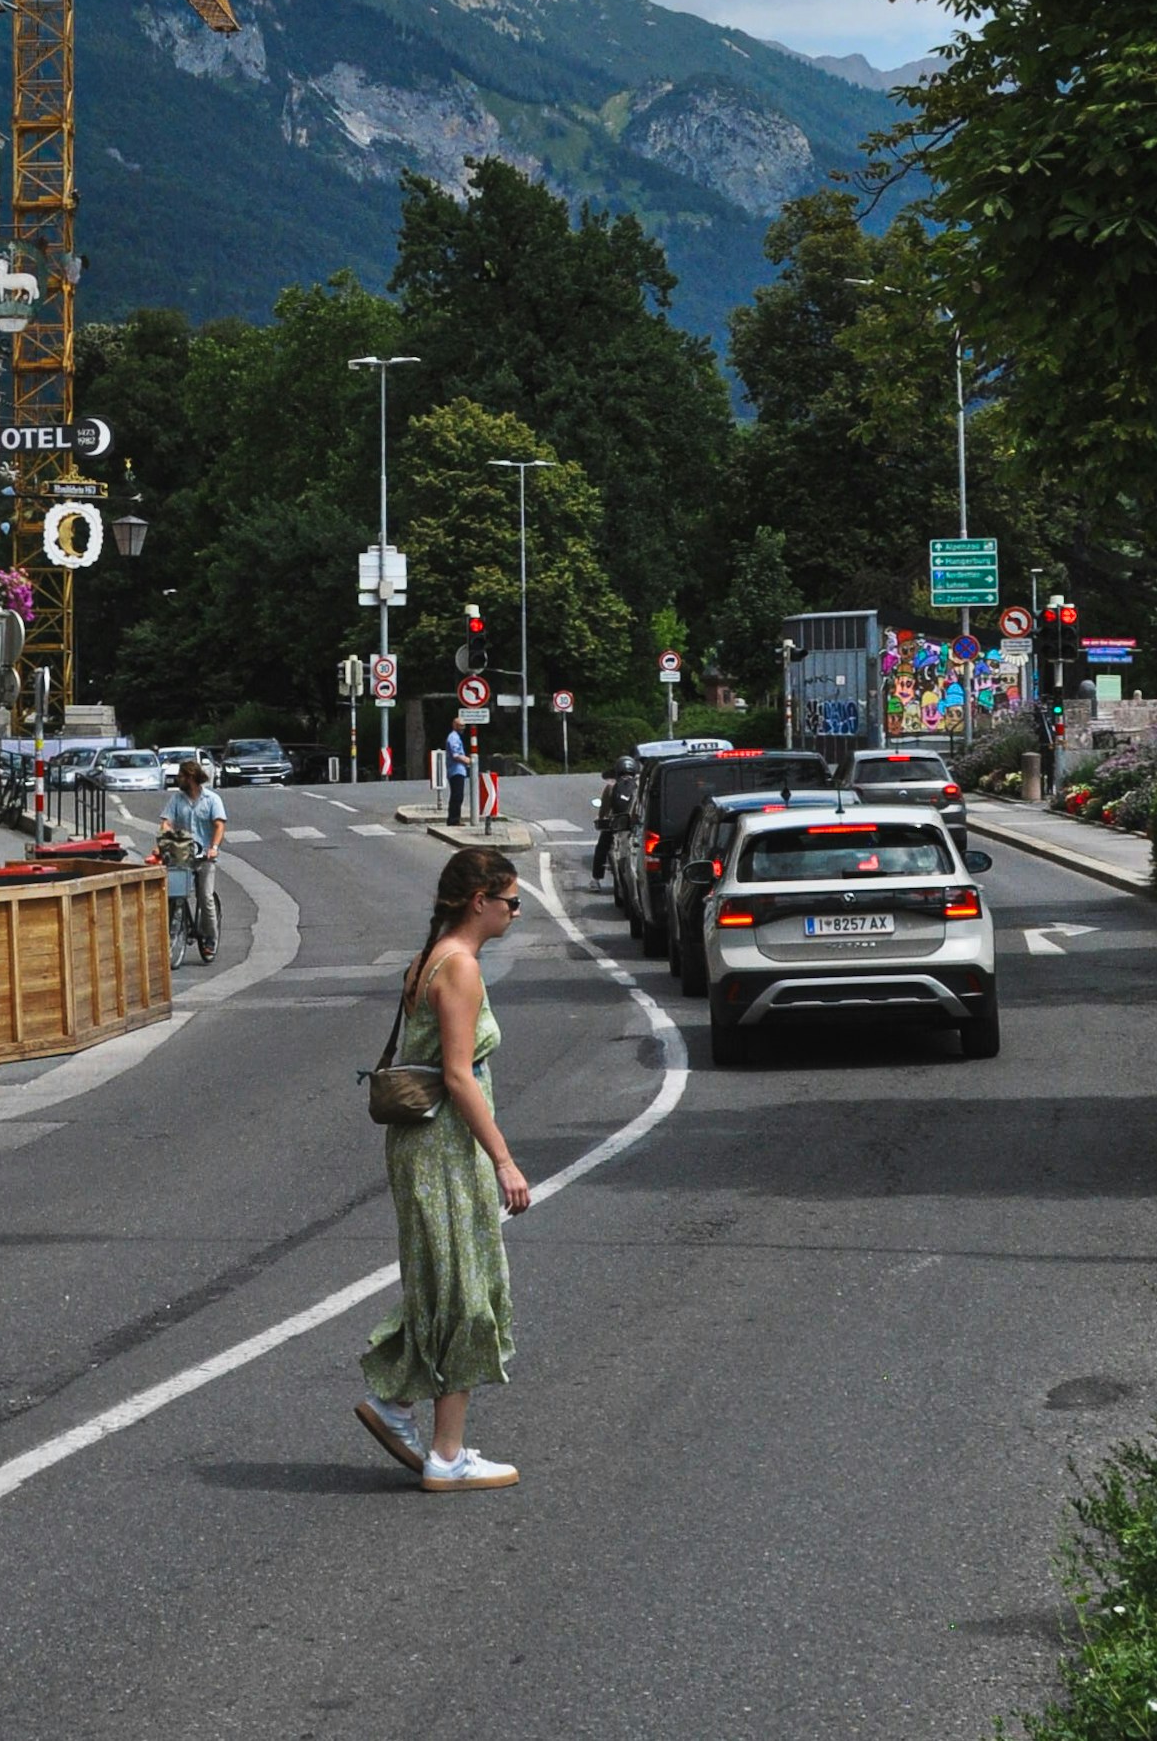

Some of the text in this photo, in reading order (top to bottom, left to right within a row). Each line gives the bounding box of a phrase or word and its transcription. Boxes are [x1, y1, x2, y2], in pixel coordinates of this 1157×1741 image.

[379, 664, 390, 673] 30
[559, 696, 569, 705] 30
[691, 742, 719, 750] TAXI
[834, 917, 866, 931] 8257
[870, 916, 888, 930] AX
